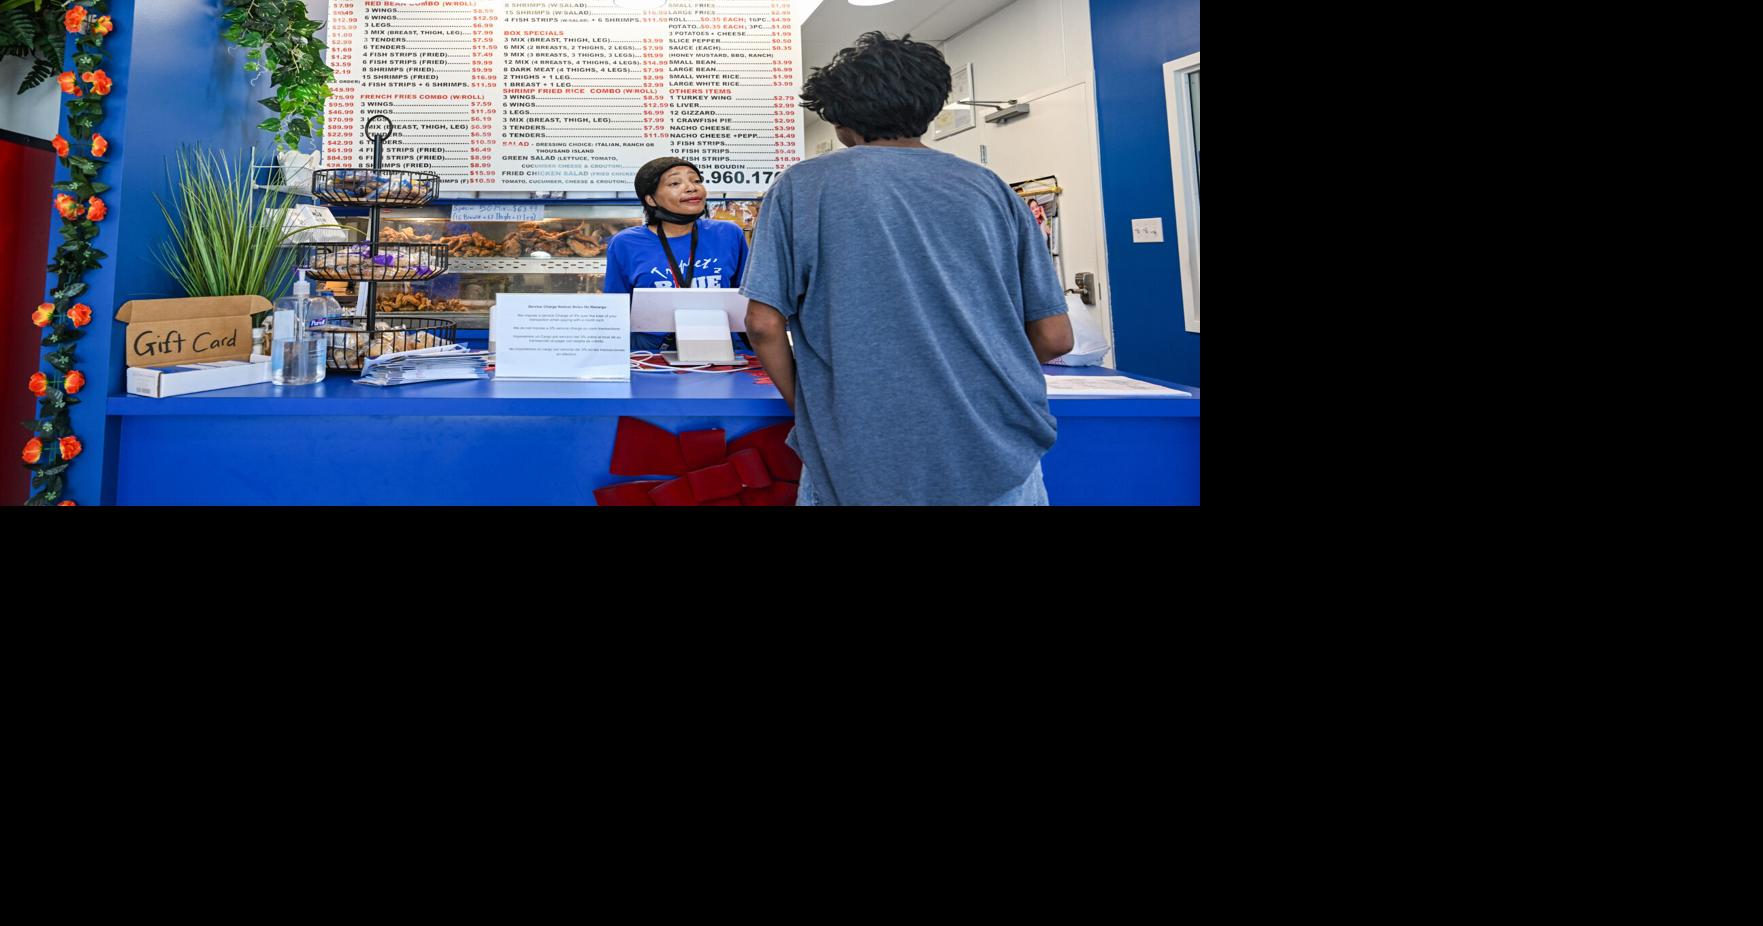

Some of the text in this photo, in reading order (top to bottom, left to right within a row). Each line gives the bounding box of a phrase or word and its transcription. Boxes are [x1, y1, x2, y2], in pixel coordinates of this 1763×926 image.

[654, 275, 722, 288] BUE
[134, 329, 237, 356] Gift Card
